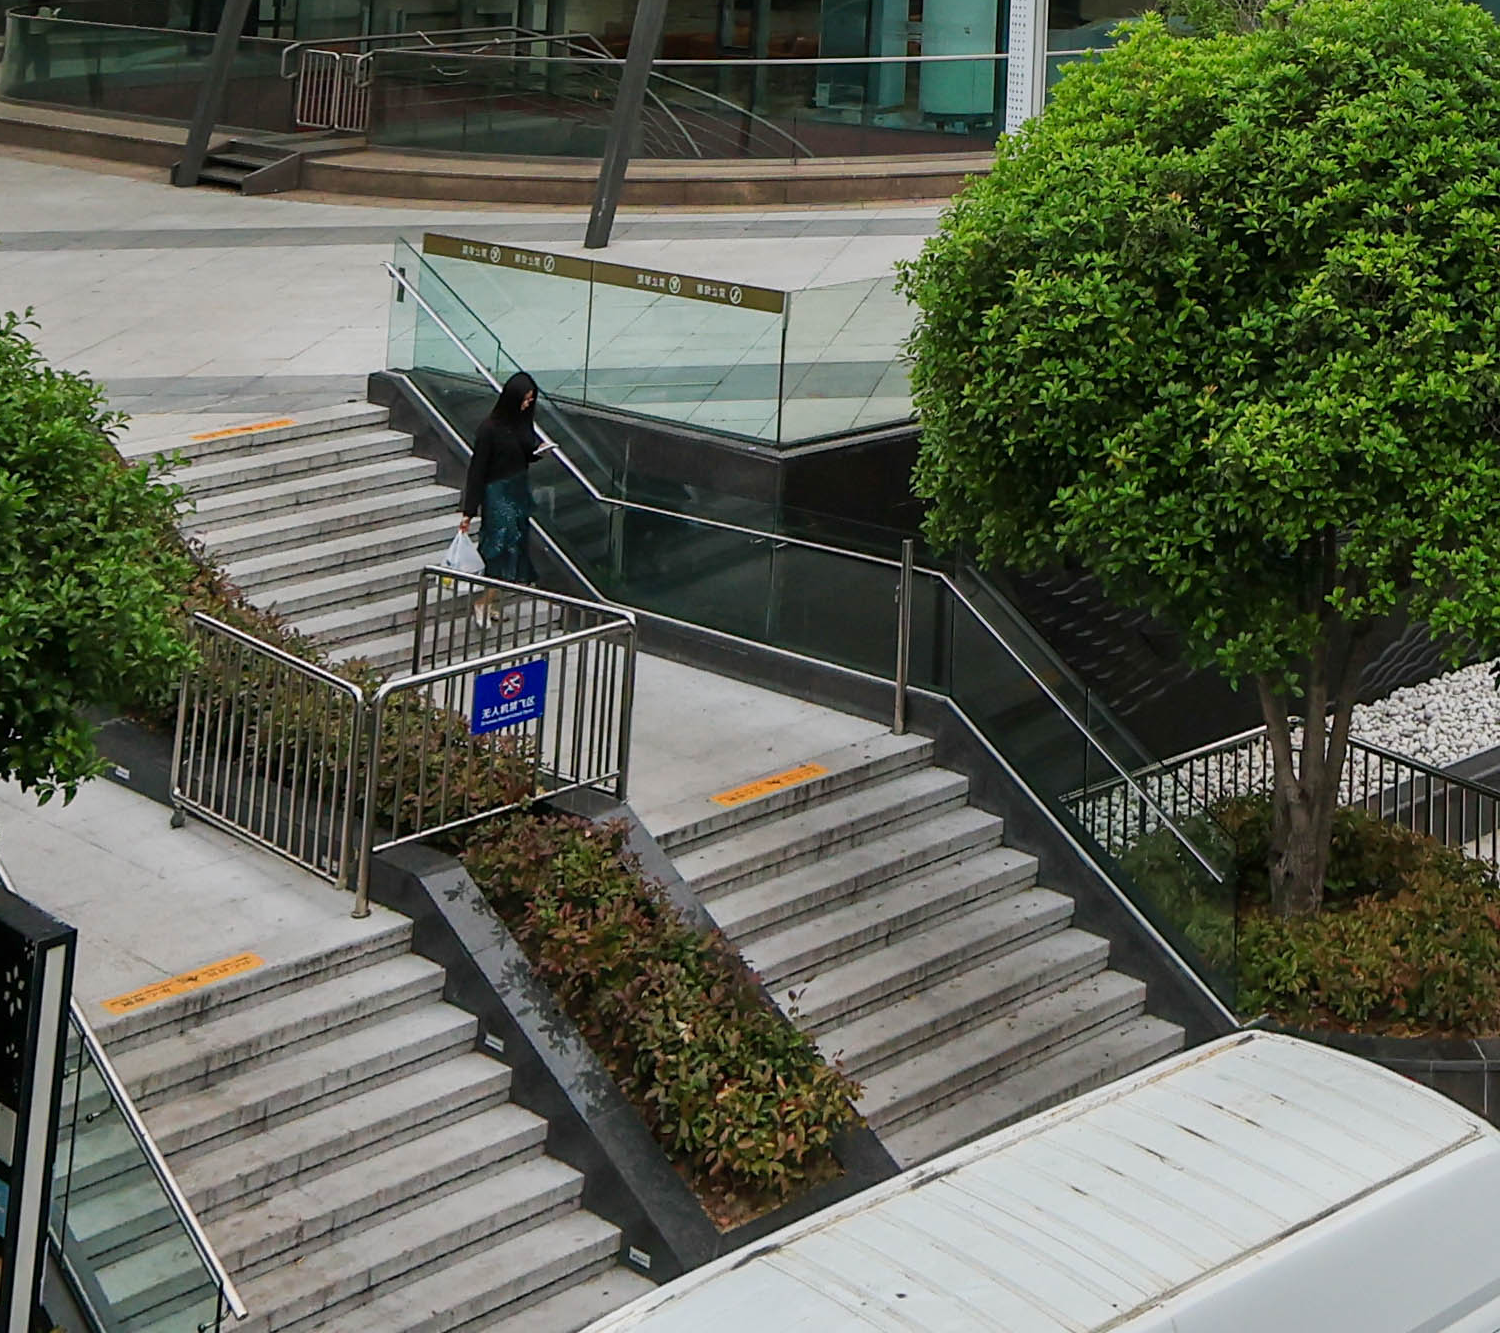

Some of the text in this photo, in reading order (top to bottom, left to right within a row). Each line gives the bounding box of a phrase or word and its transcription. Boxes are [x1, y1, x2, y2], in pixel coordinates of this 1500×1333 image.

[481, 695, 535, 720] 无人机禁飞区
